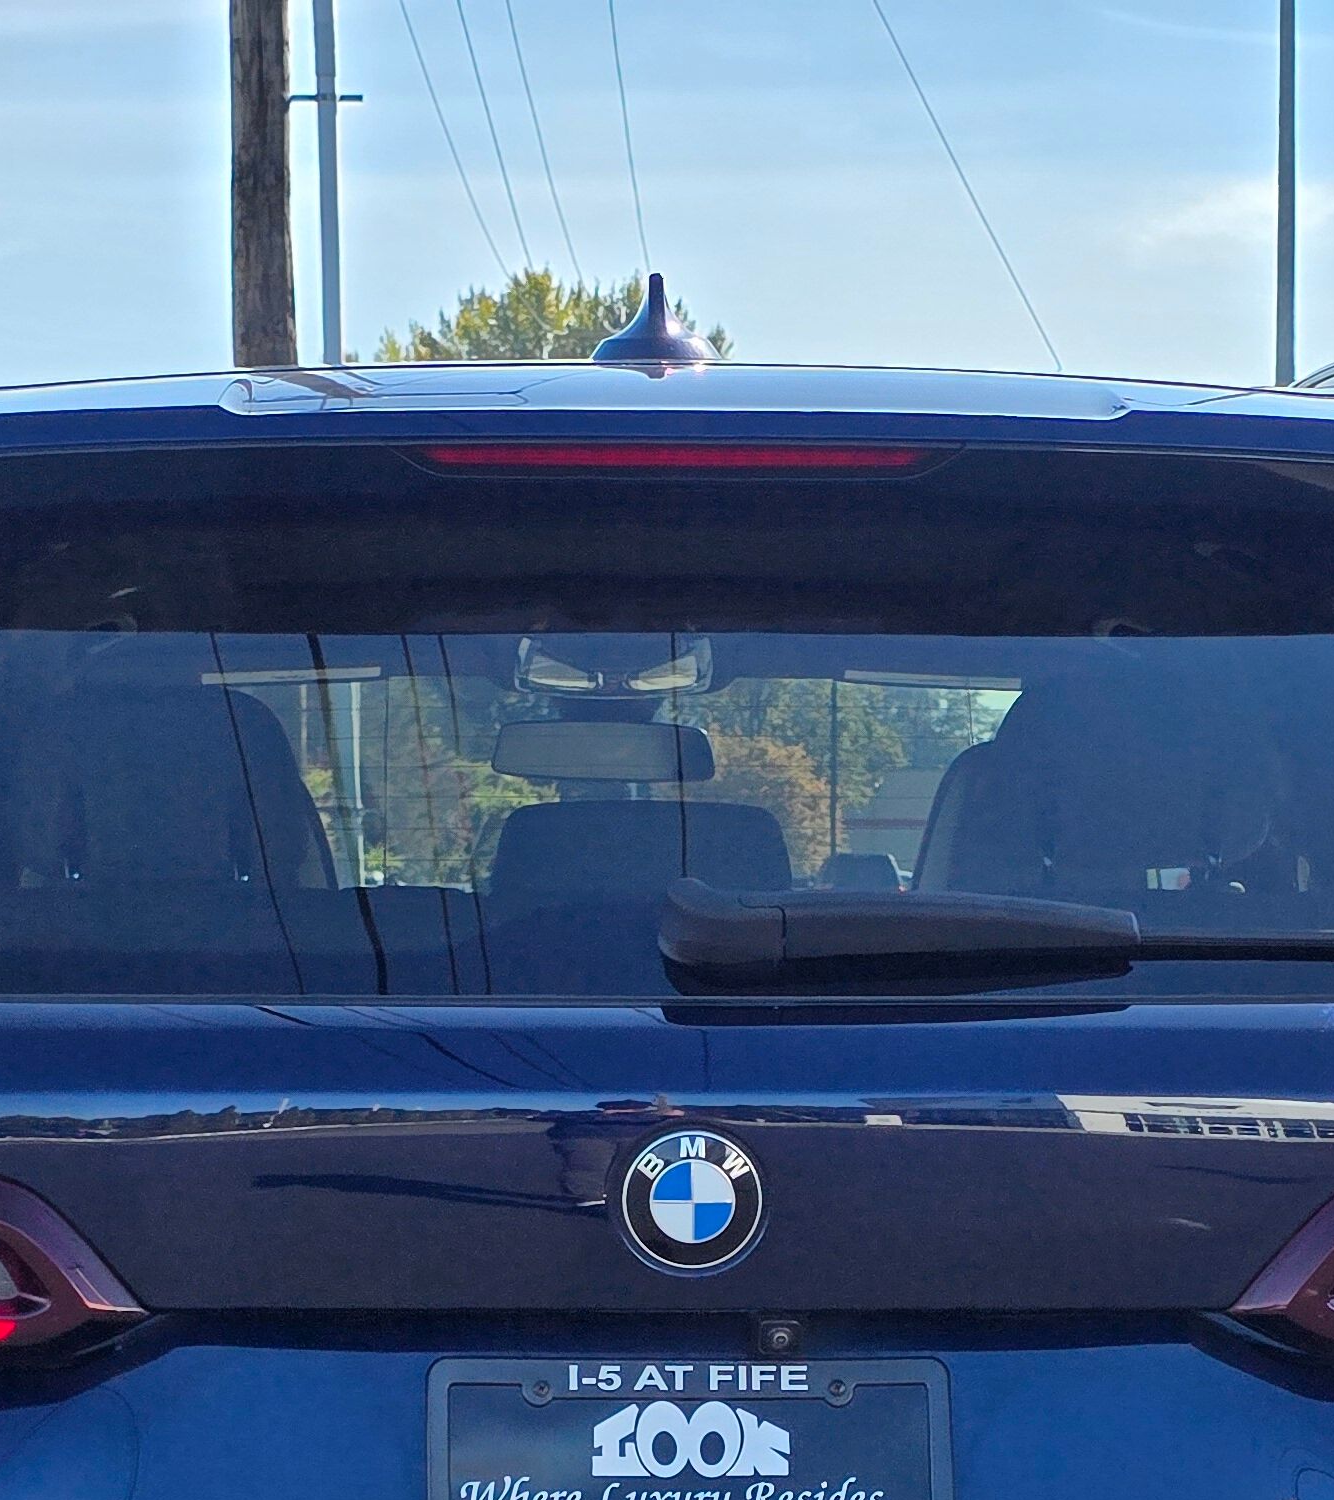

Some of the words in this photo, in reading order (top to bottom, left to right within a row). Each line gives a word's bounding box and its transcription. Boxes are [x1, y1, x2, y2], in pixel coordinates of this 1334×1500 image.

[637, 1137, 750, 1180] BMW
[569, 1365, 621, 1390] I-5
[634, 1366, 693, 1390] AT
[710, 1366, 808, 1390] FIFE
